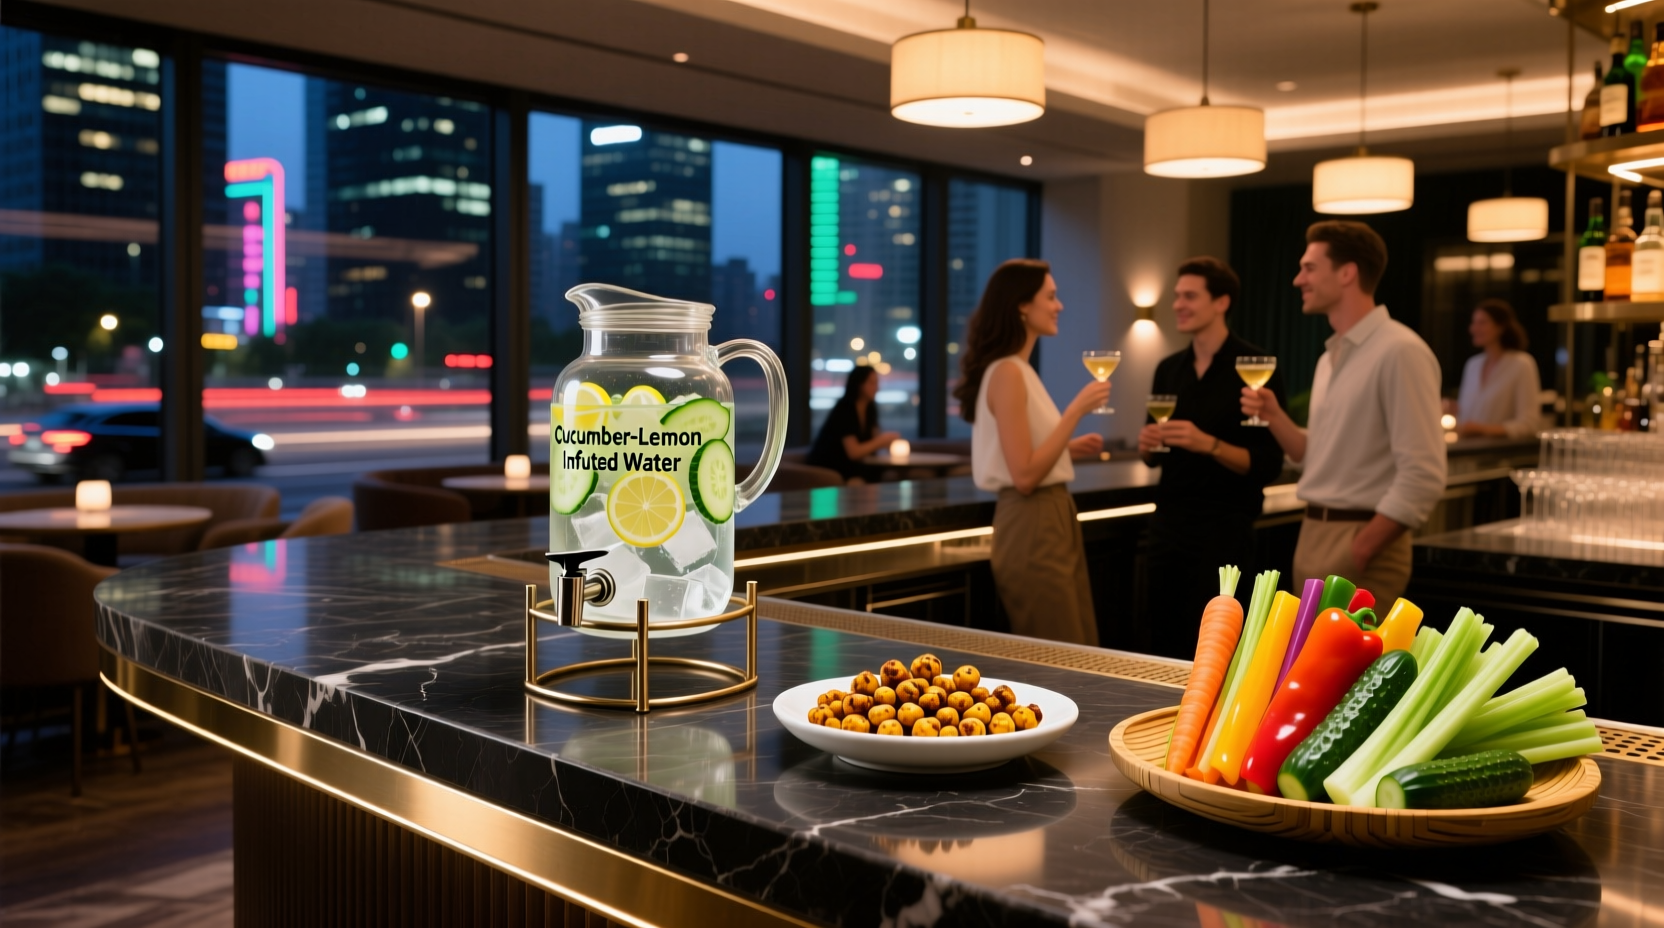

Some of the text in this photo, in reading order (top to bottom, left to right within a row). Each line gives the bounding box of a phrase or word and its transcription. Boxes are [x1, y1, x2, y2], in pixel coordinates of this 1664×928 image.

[555, 425, 702, 446] Cucumber-Lemon
[563, 450, 681, 472] Infuted Water
